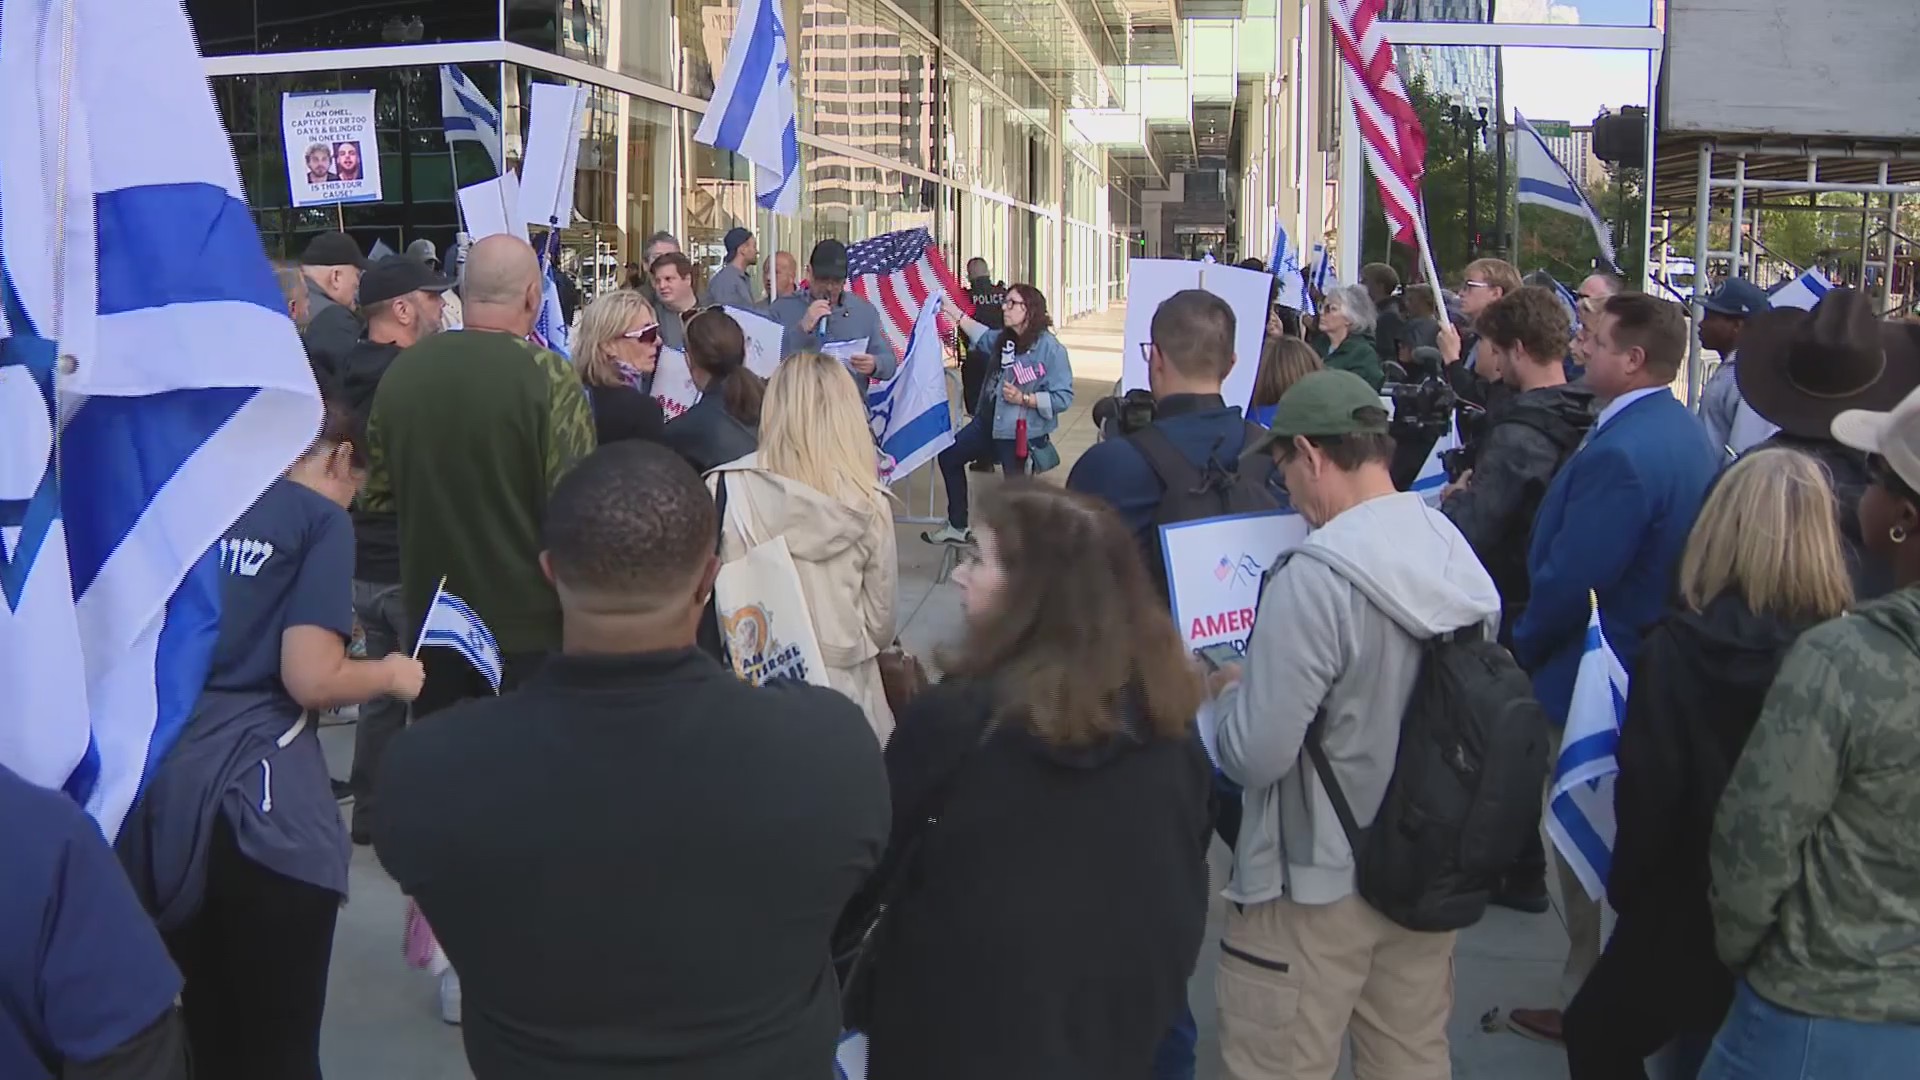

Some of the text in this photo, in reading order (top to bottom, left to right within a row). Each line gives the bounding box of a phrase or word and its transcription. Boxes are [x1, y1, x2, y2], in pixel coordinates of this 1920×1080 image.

[306, 110, 328, 118] ALON
[291, 116, 367, 128] CAPTIVE OVER 700
[296, 124, 363, 136] DAYS & BLINDED
[318, 134, 334, 142] ONE
[341, 181, 362, 189] YOUR
[322, 190, 353, 199] CAUSE?
[972, 294, 1004, 305] POLICE
